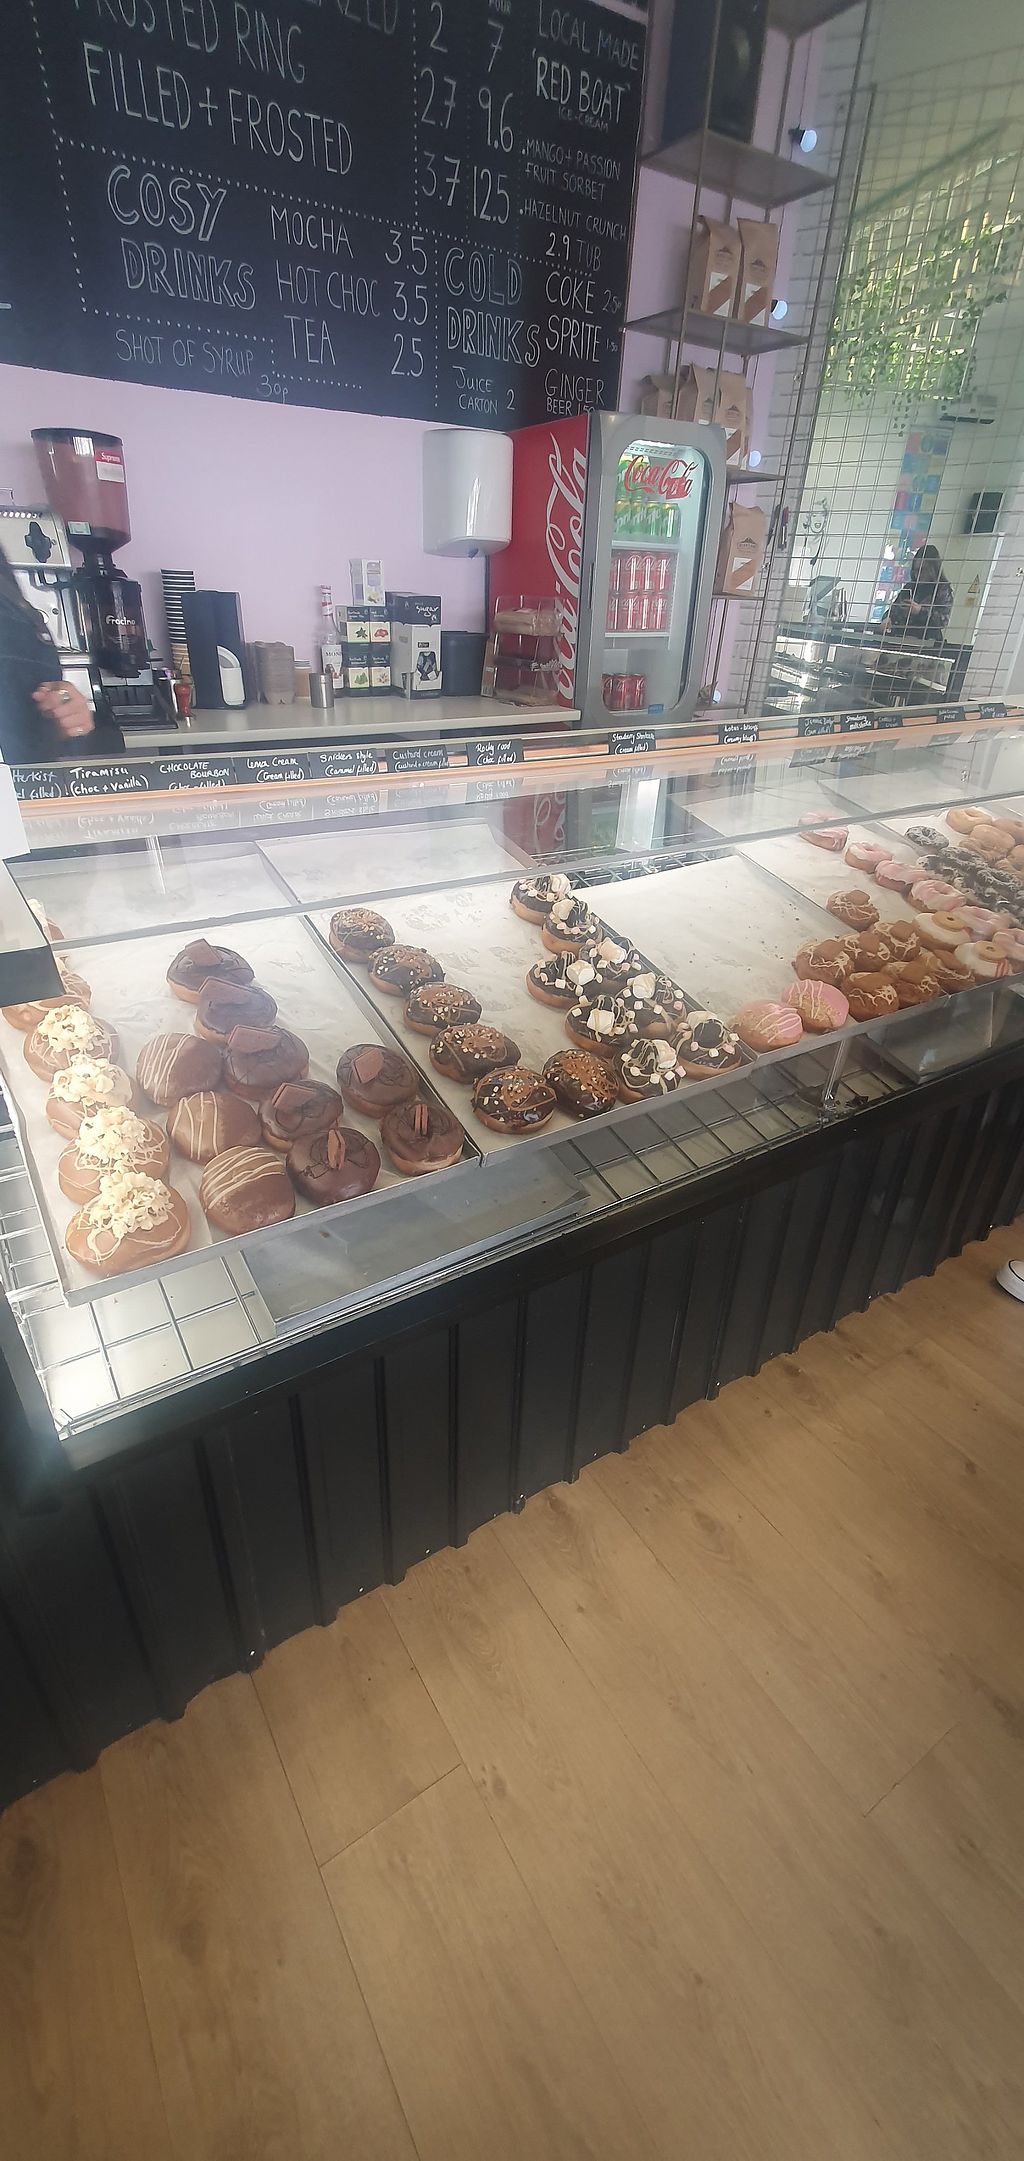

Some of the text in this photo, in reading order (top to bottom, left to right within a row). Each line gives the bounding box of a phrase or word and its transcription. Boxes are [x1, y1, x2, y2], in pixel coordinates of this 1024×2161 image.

[235, 2, 305, 84] RING
[430, 1, 448, 53] 2
[487, 18, 504, 72] 7
[538, 0, 638, 71] LOCAL MADE
[83, 42, 352, 175] FILLED + FROSTED
[421, 67, 513, 152] 2.7 9.6
[422, 151, 509, 224] 3.7 12.5
[525, 161, 606, 201] FRUIT SORBET
[576, 150, 621, 182] PASSION
[107, 164, 226, 242] COSY
[523, 199, 627, 241] HAZELNUT CRUNCH
[271, 204, 427, 275] MOCHA 3.5
[546, 232, 601, 271] 2.9 TUB
[121, 238, 256, 311] DRINKS
[276, 260, 428, 326] HOT CHOC 3.5
[444, 247, 522, 306] COLD
[545, 271, 596, 315] COKE
[115, 328, 254, 378] SHOT OF SYRUP
[284, 314, 425, 378] TEA 2.5
[447, 306, 541, 368] DRINKS
[545, 314, 602, 363] SPRITE
[458, 388, 516, 415] CARTON 2
[544, 368, 605, 407] GINGER
[546, 396, 573, 416] BEER
[70, 766, 129, 780] Tiramisu
[159, 761, 210, 773] CHOCOLATE
[190, 767, 230, 779] BOURBON
[392, 749, 421, 761] Custard
